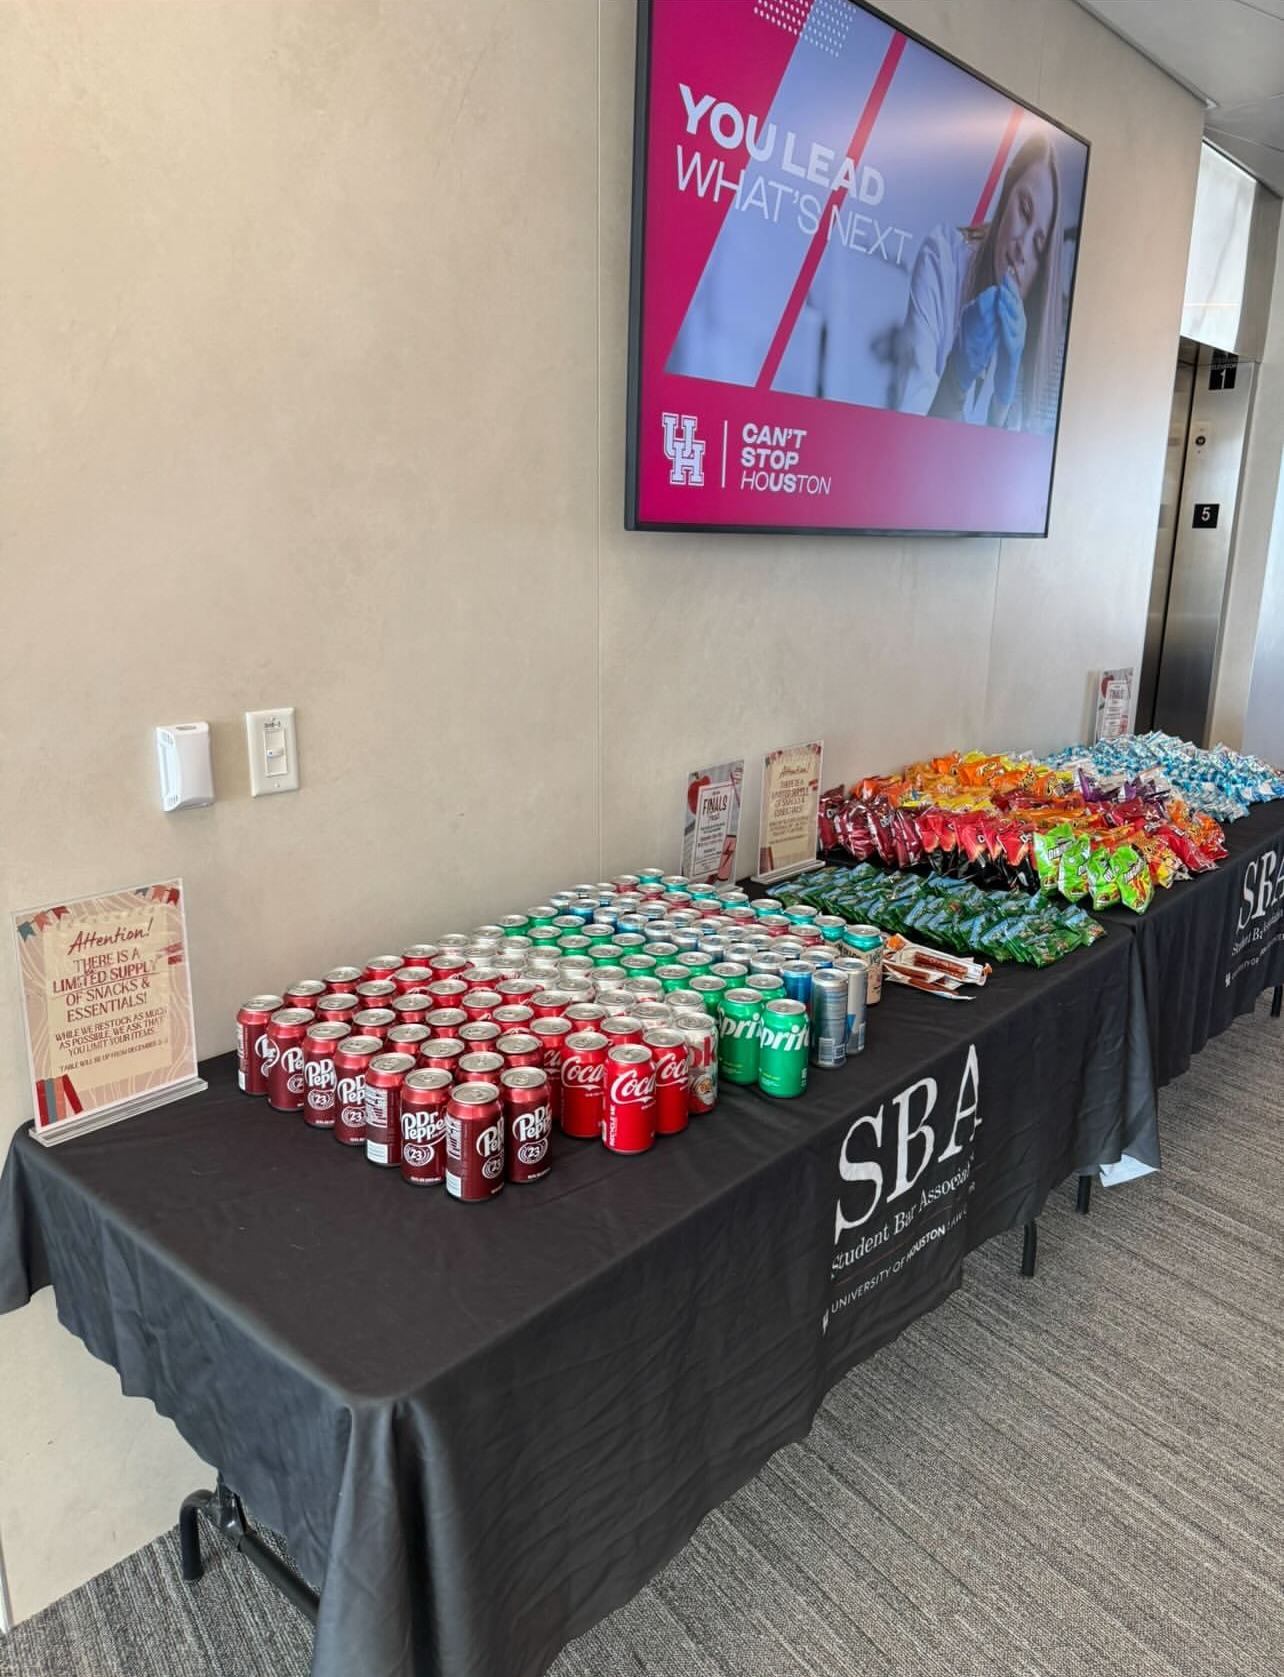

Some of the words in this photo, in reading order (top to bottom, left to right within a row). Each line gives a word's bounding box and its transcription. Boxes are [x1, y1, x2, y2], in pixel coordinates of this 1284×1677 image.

[678, 82, 777, 162] YOU
[781, 131, 885, 206] LEAD
[676, 144, 822, 236] WHAT'S
[826, 204, 913, 265] NEXT
[1219, 369, 1227, 389] 1
[741, 422, 807, 449] CAN'T
[740, 447, 799, 470] STOP
[740, 471, 832, 495] HOUSTON
[1201, 506, 1211, 522] 5
[702, 794, 728, 816] FINALS
[67, 916, 154, 956] Attention!
[73, 953, 114, 973] THERE
[117, 949, 129, 963] IS
[131, 947, 140, 961] A
[53, 970, 107, 993] LIMITED
[110, 959, 157, 981] SUPPLY
[66, 992, 81, 1006] OF
[87, 979, 138, 1002] SNACKS
[141, 977, 150, 989] &
[67, 992, 147, 1022] ESSENTIALS!
[81, 1025, 94, 1036] WE
[59, 1040, 71, 1050] AS
[68, 1046, 86, 1057] YOU
[109, 1033, 130, 1046] YOUR
[315, 1094, 327, 1104] 23
[350, 1111, 362, 1121] 23
[415, 1111, 438, 1124] Dr
[410, 1149, 422, 1160] 23
[527, 1146, 540, 1158] 23
[833, 1043, 983, 1246] SBA
[893, 1202, 917, 1236] Bar
[831, 1266, 892, 1314] UNIVERSITY
[892, 1257, 905, 1273] OF
[905, 1223, 946, 1263] HOUSTON
